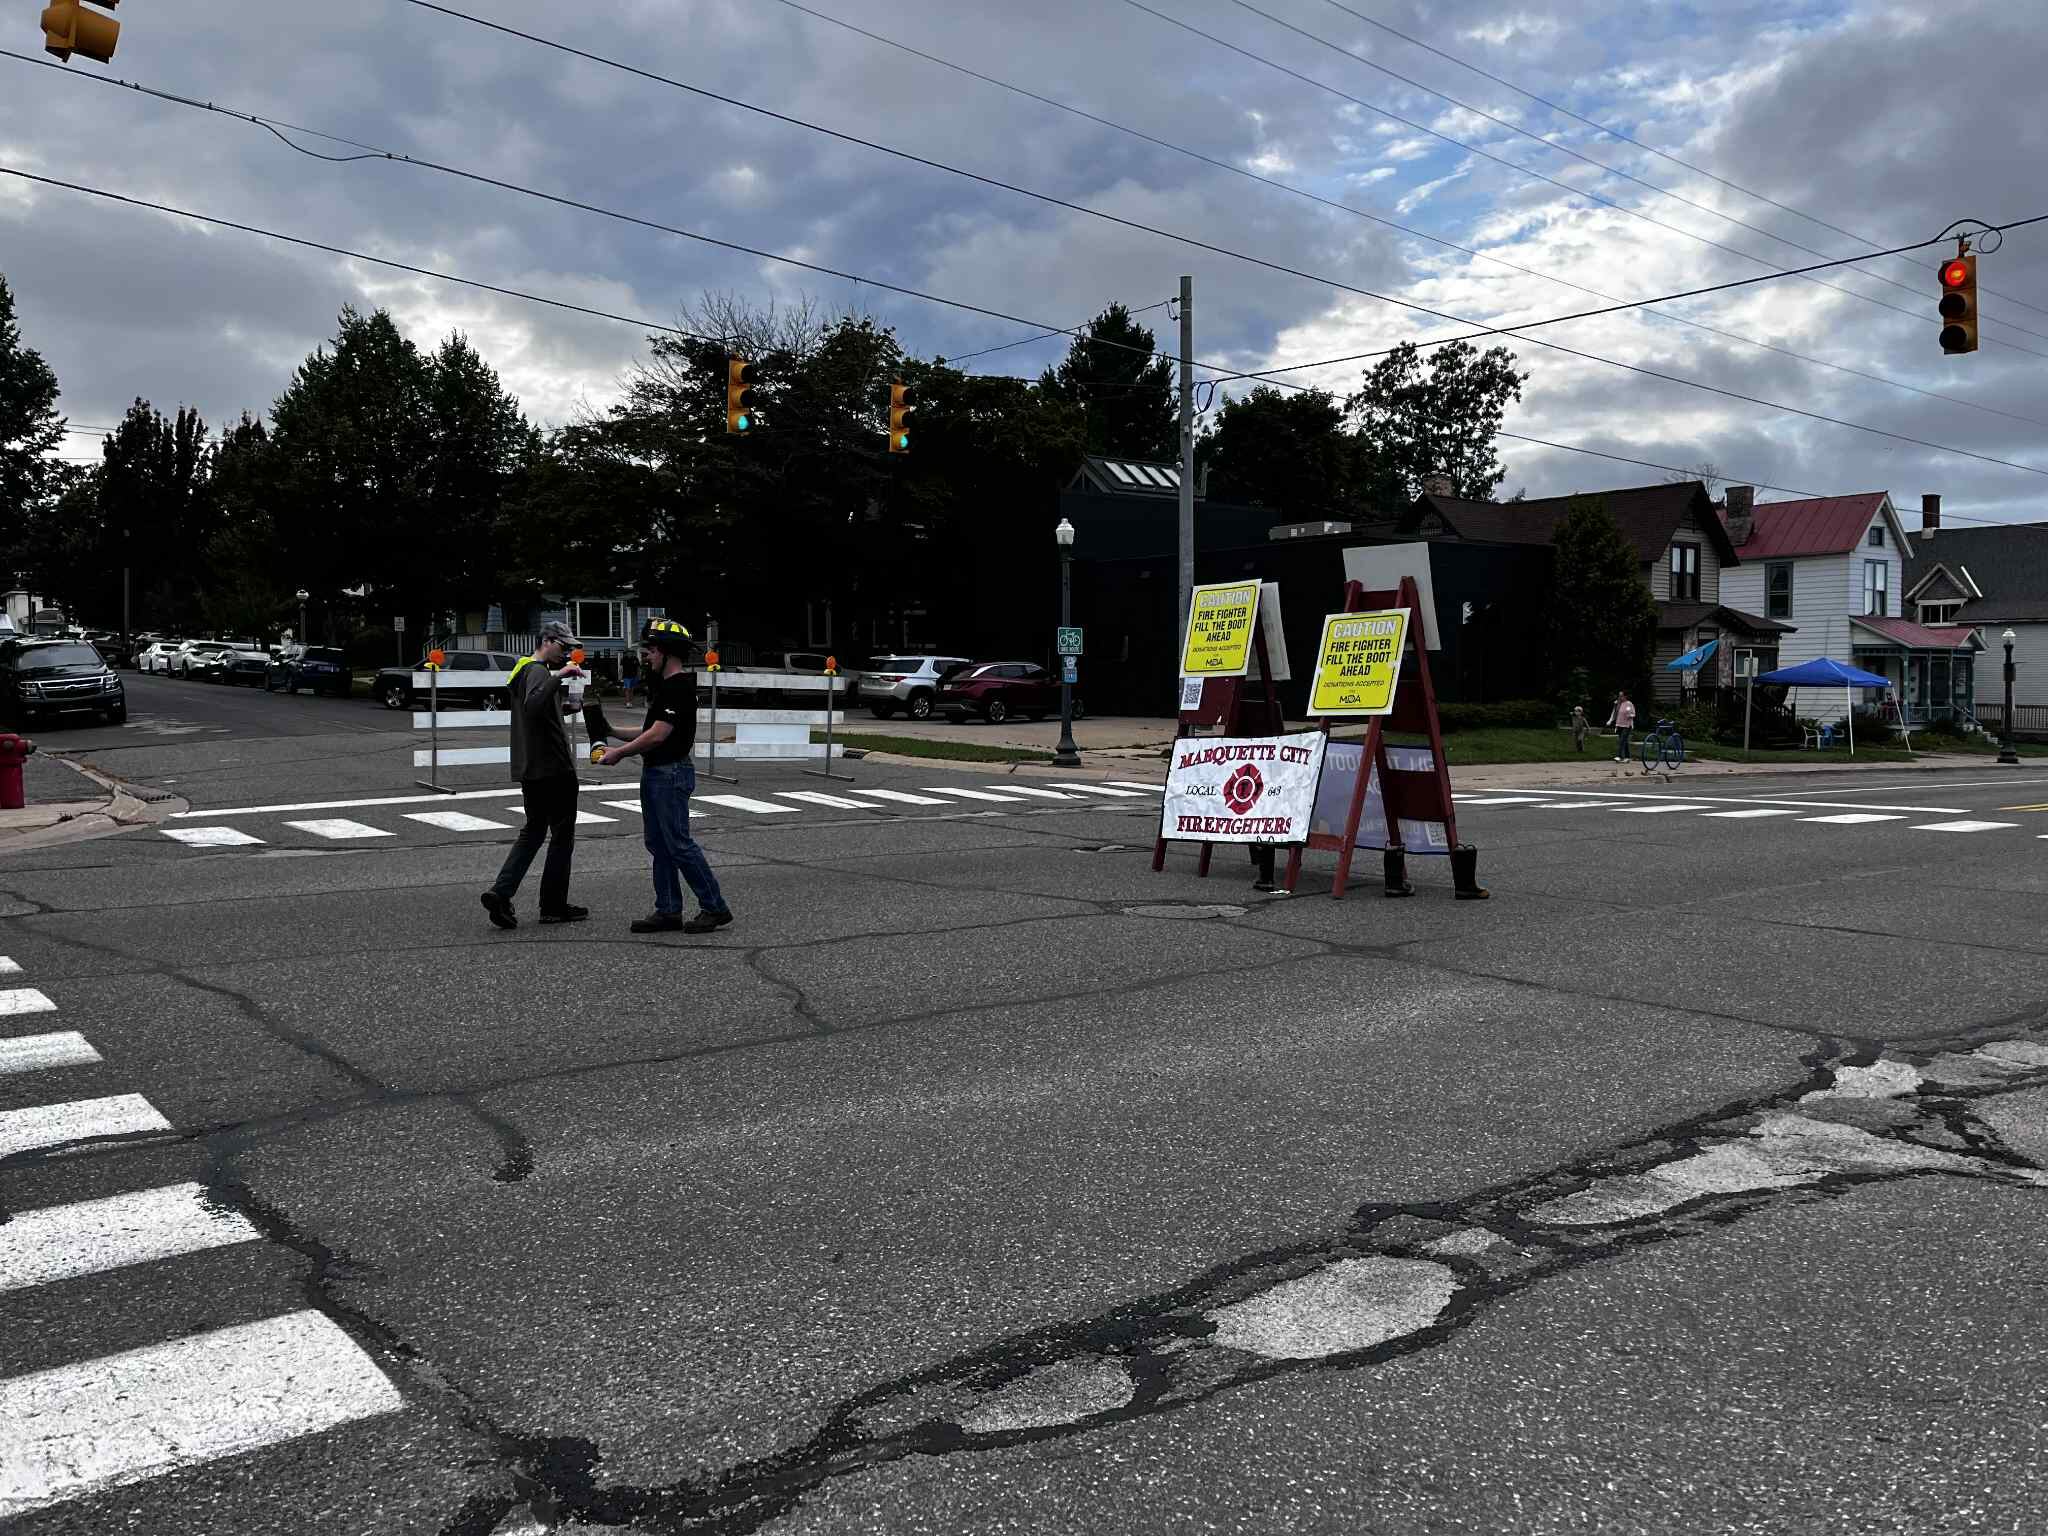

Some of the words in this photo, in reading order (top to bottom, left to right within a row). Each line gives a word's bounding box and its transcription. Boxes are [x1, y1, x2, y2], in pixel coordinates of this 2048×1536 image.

[1198, 610, 1214, 620] FIRE
[1217, 608, 1247, 619] FIGHTER
[1194, 622, 1209, 632] FILL
[1213, 621, 1225, 631] THE
[1228, 619, 1247, 630] BOOT
[1334, 621, 1396, 638] CAUTION
[1206, 631, 1231, 642] AHEAD
[1330, 641, 1350, 652] FIRE
[1352, 639, 1391, 651] FIGHTER
[1326, 654, 1343, 665] FILL
[1346, 653, 1364, 665] THE
[1366, 652, 1391, 663] BOOT
[1340, 665, 1371, 676] AHEAD
[1177, 745, 1276, 769] MARQUETTE
[1280, 746, 1312, 765] CITY
[1185, 785, 1216, 795] LOCAL
[1177, 815, 1292, 834] FIREFIGHTERS
